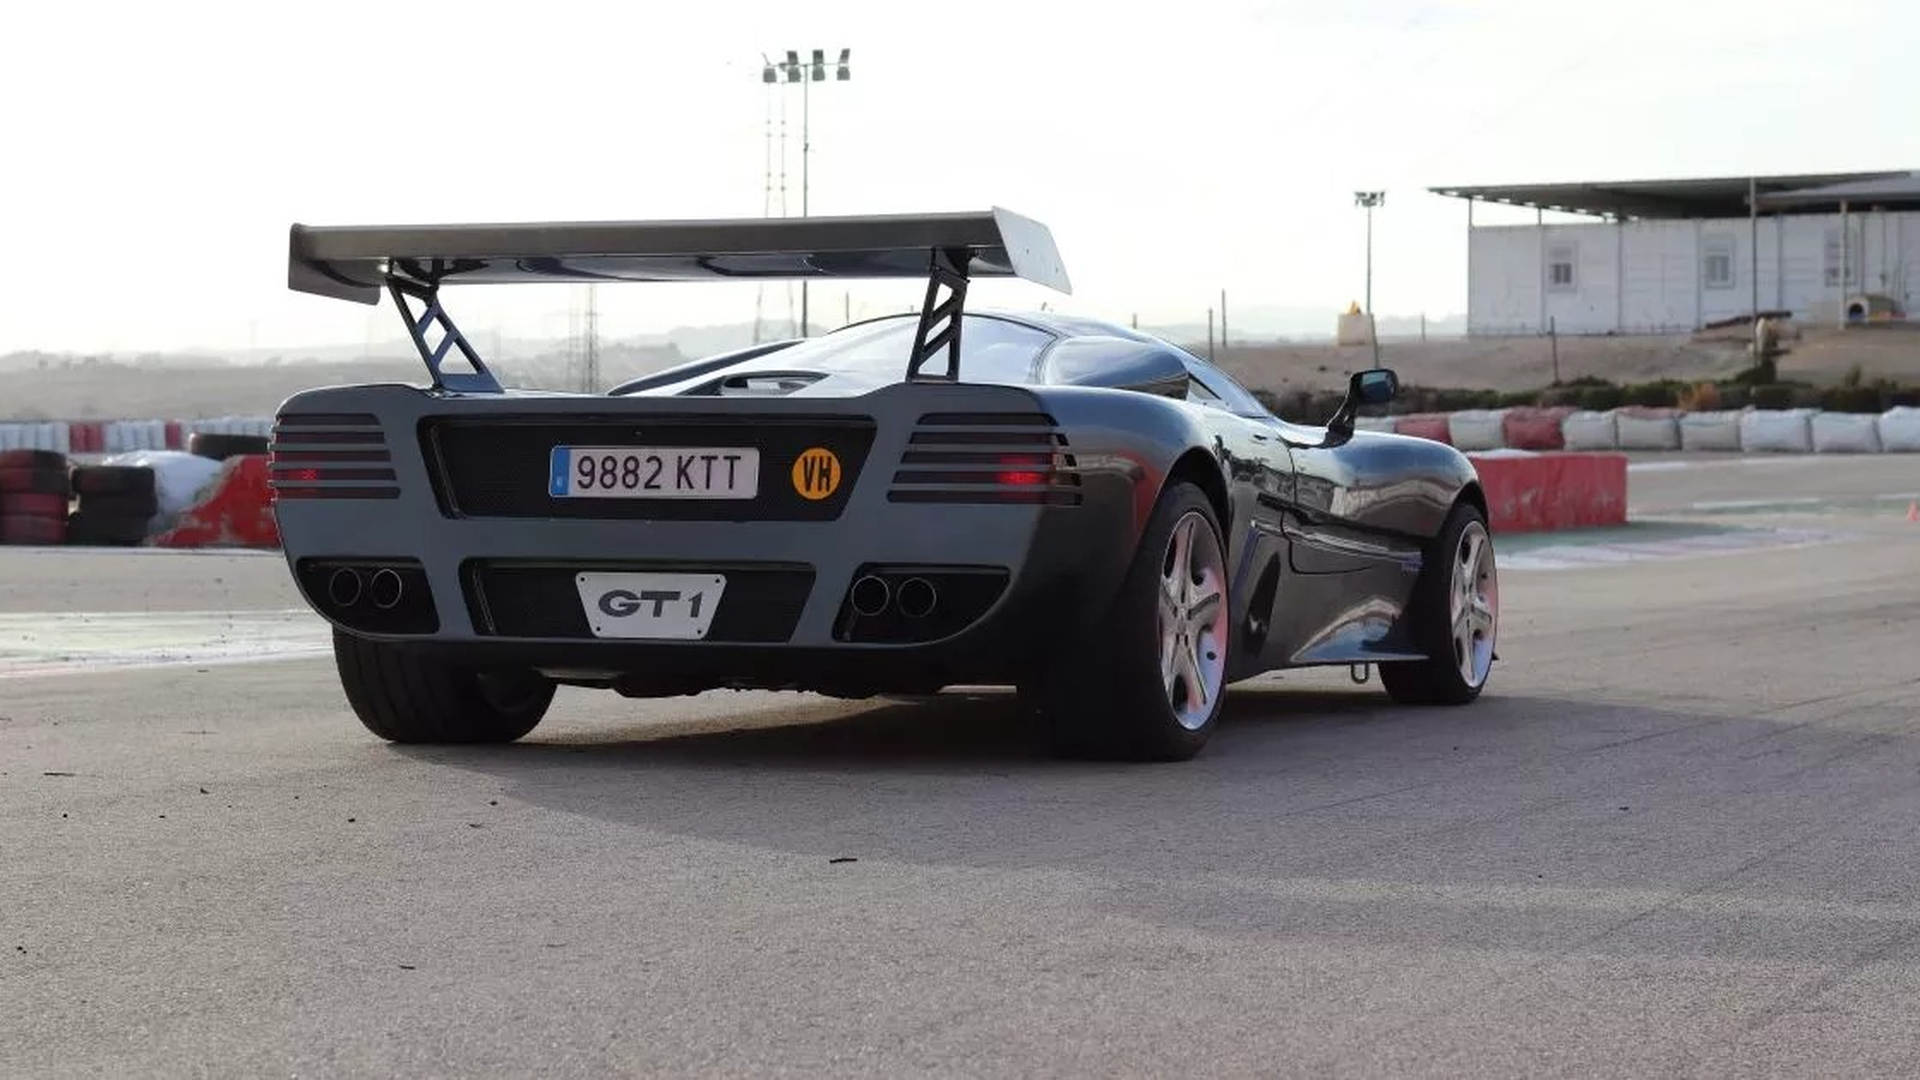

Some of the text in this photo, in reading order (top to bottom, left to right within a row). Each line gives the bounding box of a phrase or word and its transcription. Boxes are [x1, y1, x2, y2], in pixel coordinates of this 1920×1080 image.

[577, 455, 742, 490] 9882 KTT
[803, 455, 832, 492] VH
